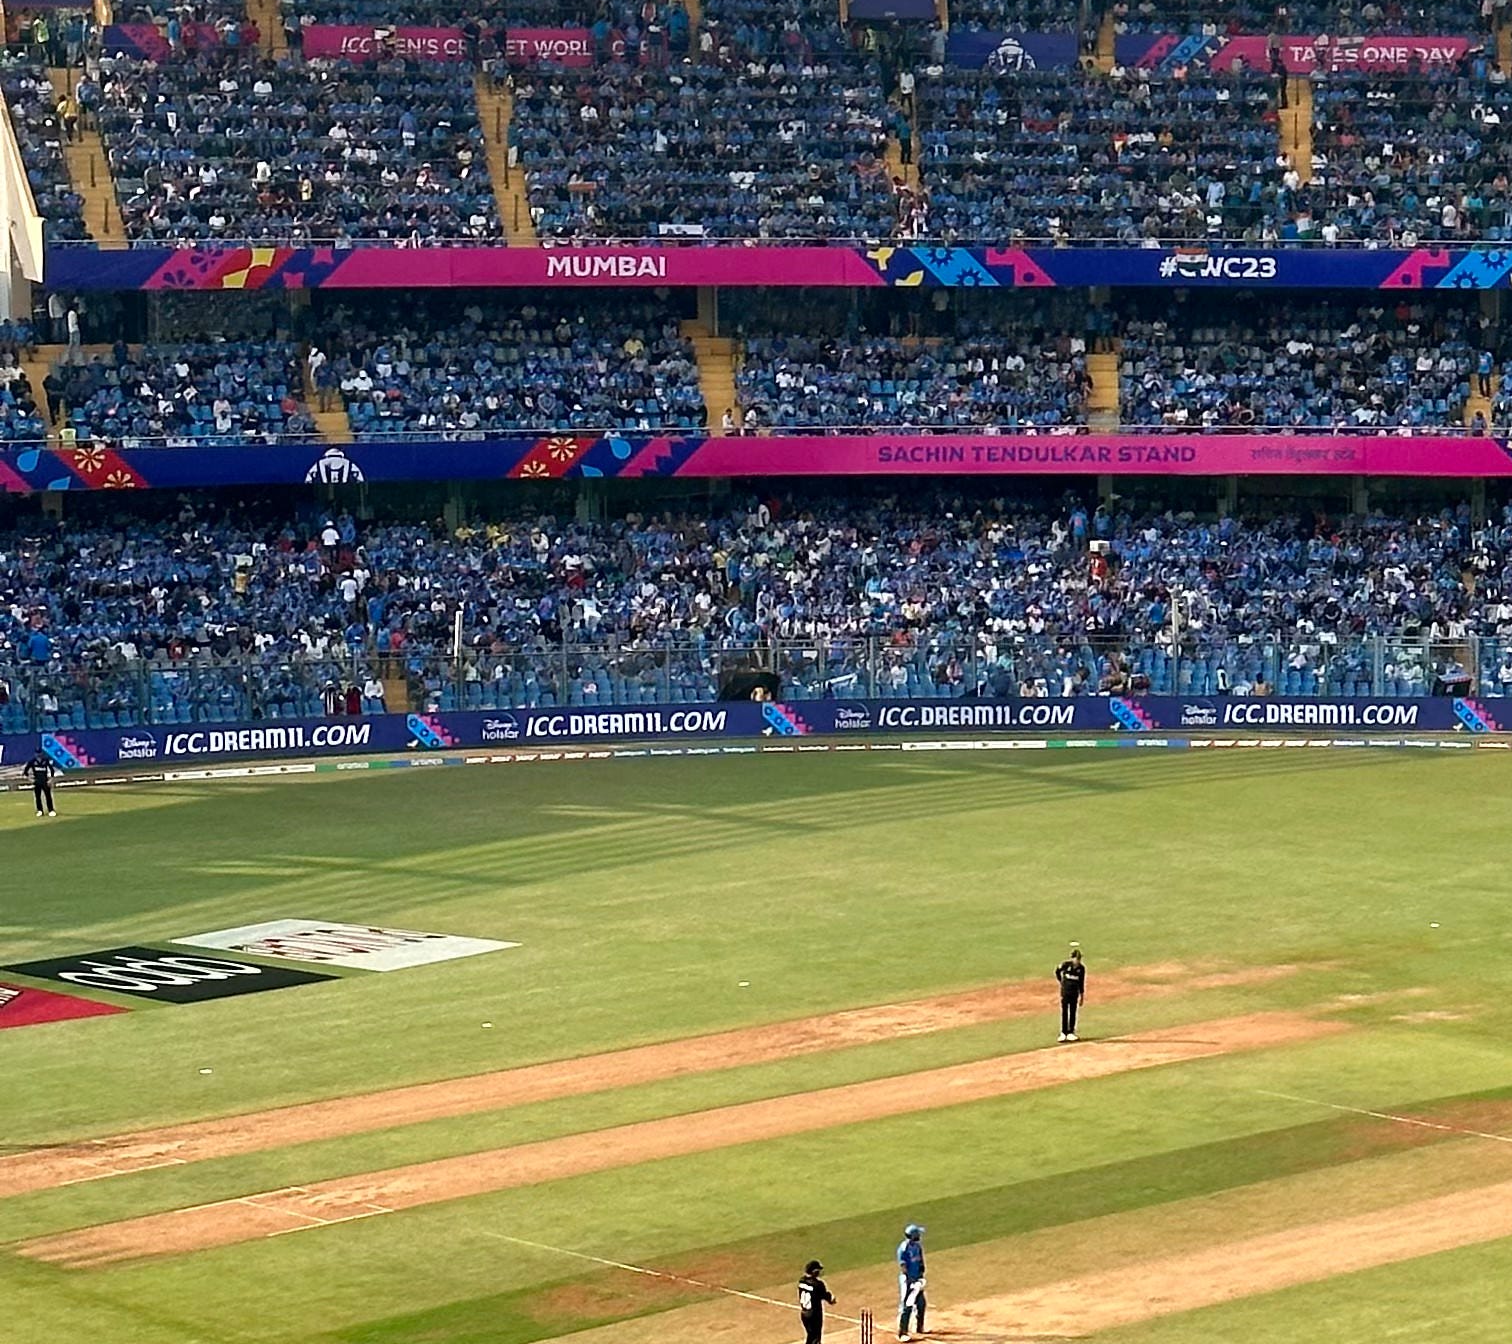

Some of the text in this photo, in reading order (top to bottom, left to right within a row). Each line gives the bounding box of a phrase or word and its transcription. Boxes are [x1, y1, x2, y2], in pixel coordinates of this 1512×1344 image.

[340, 36, 372, 53] ICC
[1289, 45, 1359, 63] TAES
[1363, 47, 1407, 63] ONE
[546, 256, 667, 277] MUMBAI
[877, 445, 1197, 464] SACHIN TENDULKAR STAND
[526, 710, 726, 737] ICC.DREAM11.COM
[877, 704, 1075, 728] ICC.DREAM11.COM
[1223, 702, 1418, 726] ICC.DREAM11.COM
[164, 724, 371, 756] ICC.DREAM11.COM
